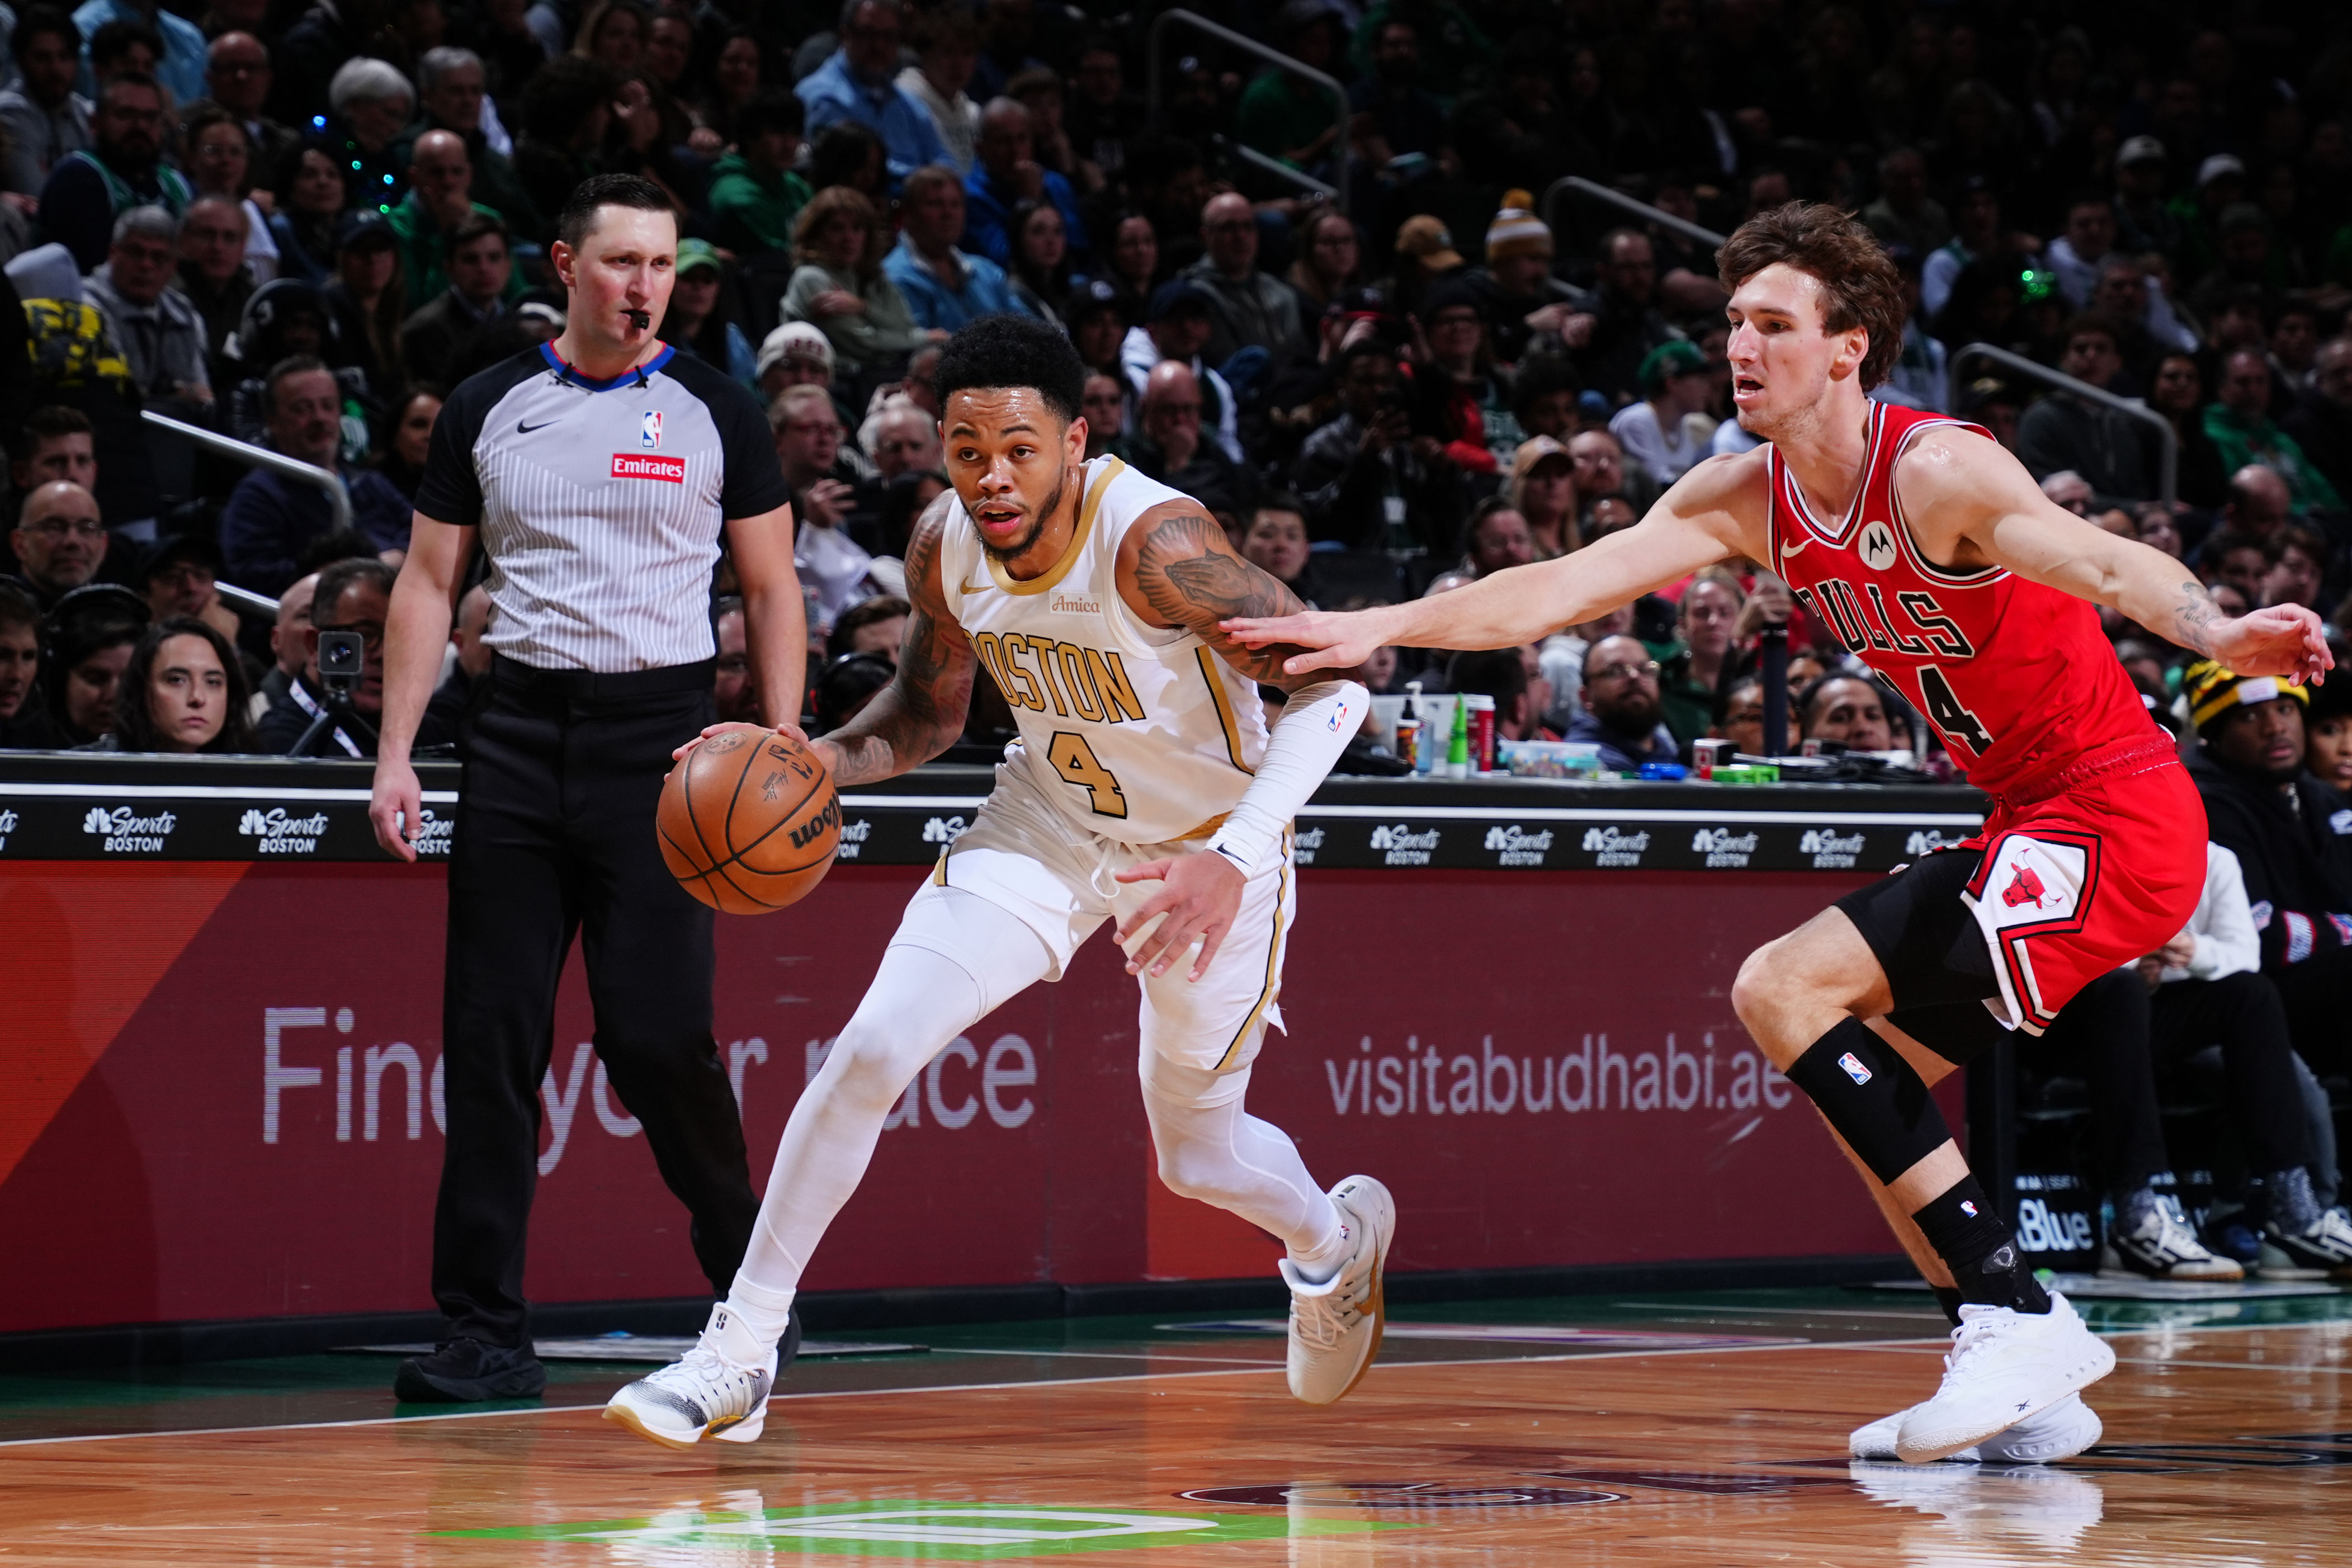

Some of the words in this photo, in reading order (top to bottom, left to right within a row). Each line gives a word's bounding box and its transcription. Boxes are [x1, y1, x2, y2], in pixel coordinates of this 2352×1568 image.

[613, 457, 683, 478] Emirates
[1052, 596, 1101, 613] Amica
[962, 628, 1147, 724] OSTON
[1047, 730, 1128, 820] 4
[111, 806, 177, 839] Sports
[265, 807, 329, 840] Sports
[103, 837, 164, 852] BOSTON
[258, 838, 317, 853] BOSTON
[263, 1007, 447, 1145] Fin
[1324, 1033, 1792, 1116] visitabudhabi.ae
